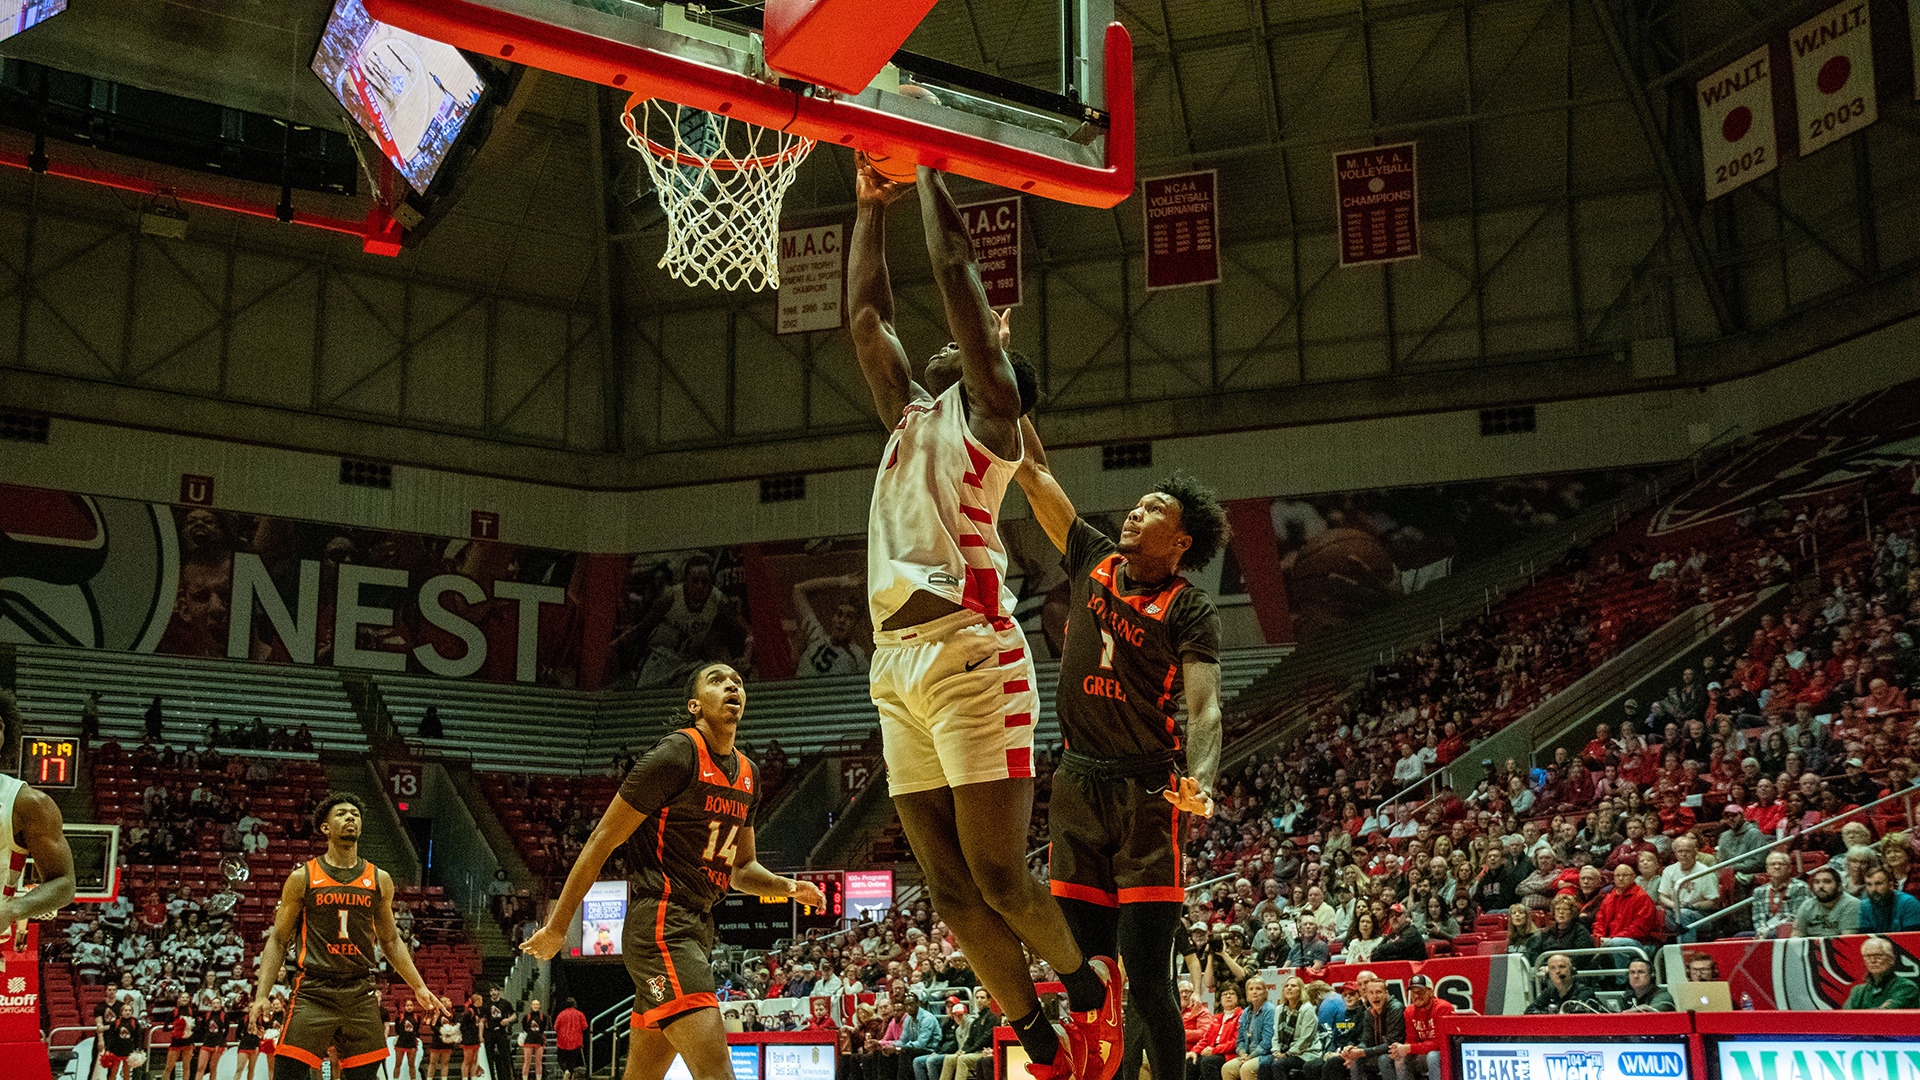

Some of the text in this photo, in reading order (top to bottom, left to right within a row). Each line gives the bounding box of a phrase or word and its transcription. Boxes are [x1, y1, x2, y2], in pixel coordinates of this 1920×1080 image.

[1794, 4, 1867, 57] W.N.I.T.
[1702, 58, 1767, 107] W.N.I.T.
[1809, 98, 1865, 139] 2003
[1339, 163, 1412, 180] VOLLEYBALL
[1716, 147, 1766, 183] 2002
[1164, 181, 1197, 194] NCAA
[1150, 191, 1210, 207] VOLLEYBALL
[1342, 190, 1412, 207] CHAMPIONS
[781, 231, 840, 260] M.A.C.
[982, 233, 1012, 247] TROPHY
[987, 245, 1018, 259] SPORTS
[188, 483, 207, 502] U
[478, 518, 493, 536] T
[227, 552, 566, 683] NEST
[1083, 675, 1127, 702] GREE
[32, 742, 73, 757] 17:19
[41, 757, 66, 782] 17
[844, 767, 869, 790] 12
[390, 774, 417, 796] 13
[704, 795, 749, 821] BOWLIN
[702, 820, 739, 866] 14
[316, 893, 371, 907] BOWLING
[338, 909, 349, 939] 1
[772, 921, 789, 929] FOULS
[0, 1006, 36, 1014] ORTGAGE
[1466, 1059, 1520, 1080] BLAKE
[1621, 1054, 1680, 1074] WMUN
